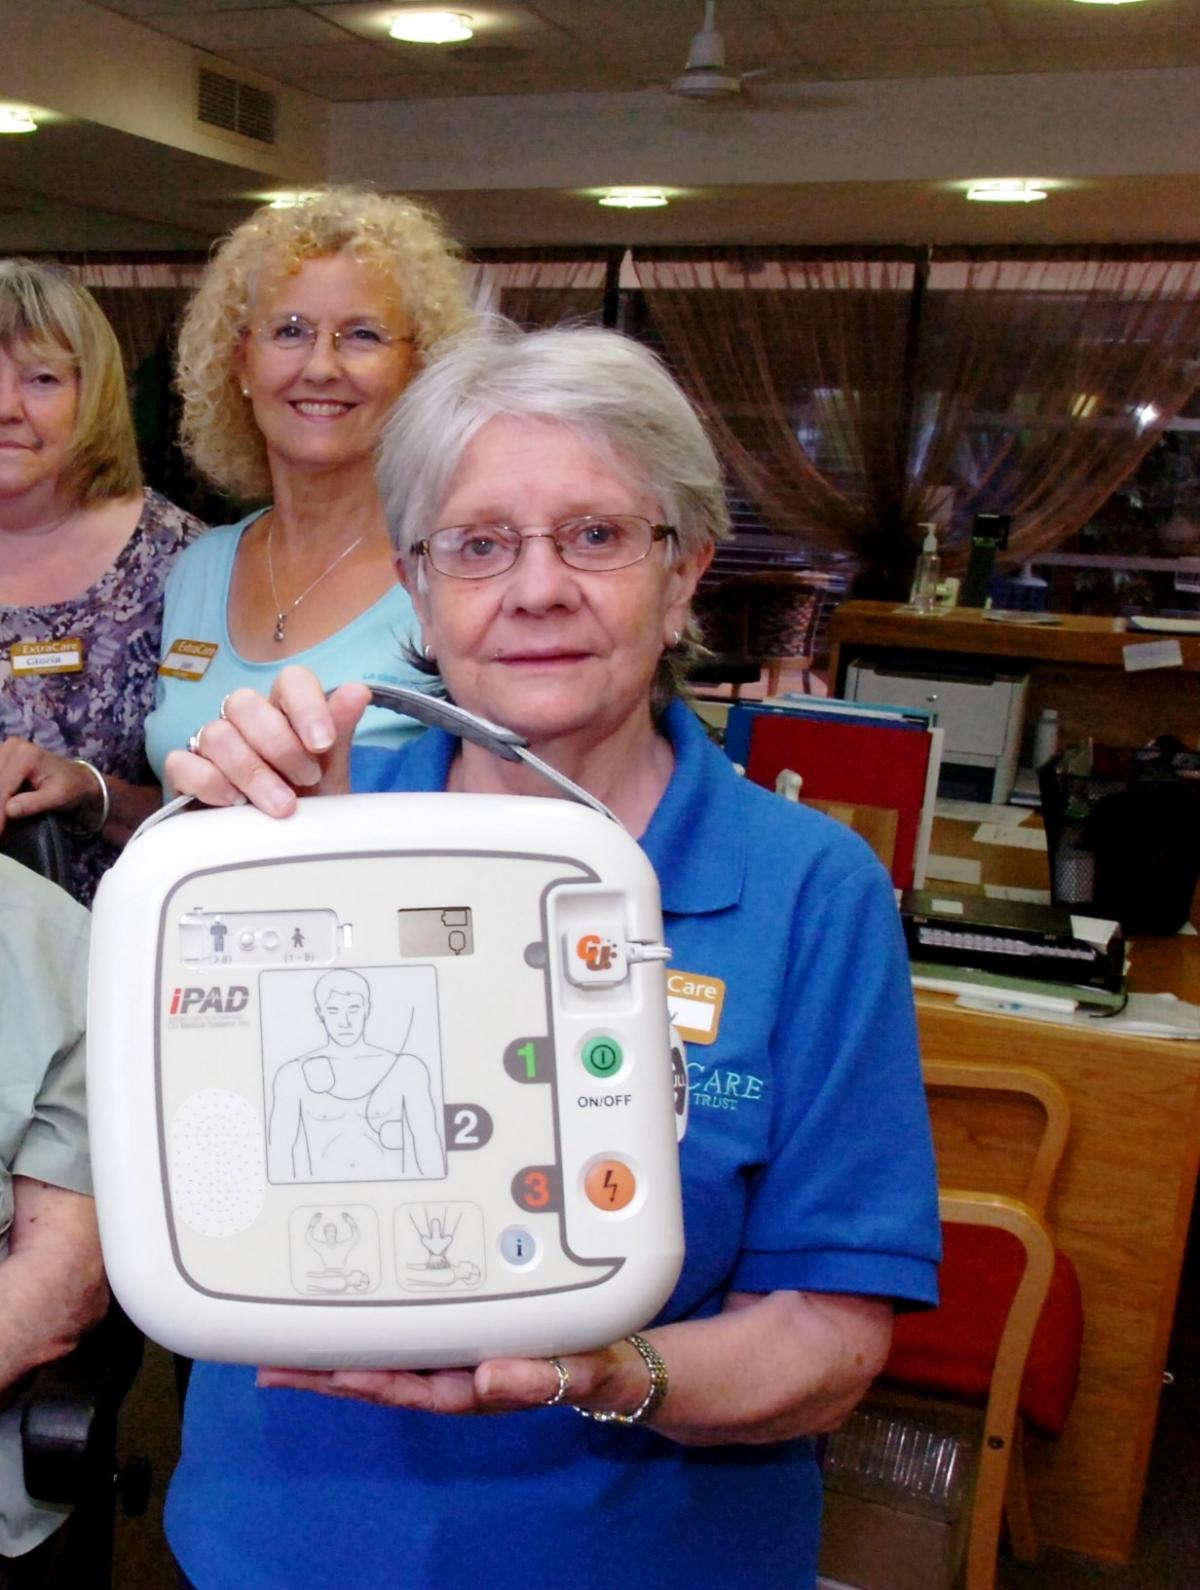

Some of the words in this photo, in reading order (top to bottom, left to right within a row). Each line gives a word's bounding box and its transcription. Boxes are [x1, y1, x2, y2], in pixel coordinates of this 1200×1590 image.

[169, 985, 250, 1015] iPAD
[516, 1042, 537, 1078] 1
[577, 1094, 632, 1108] ON/OFF
[693, 1093, 739, 1111] TRUST
[453, 1110, 480, 1144] 2
[523, 1171, 550, 1207] 3
